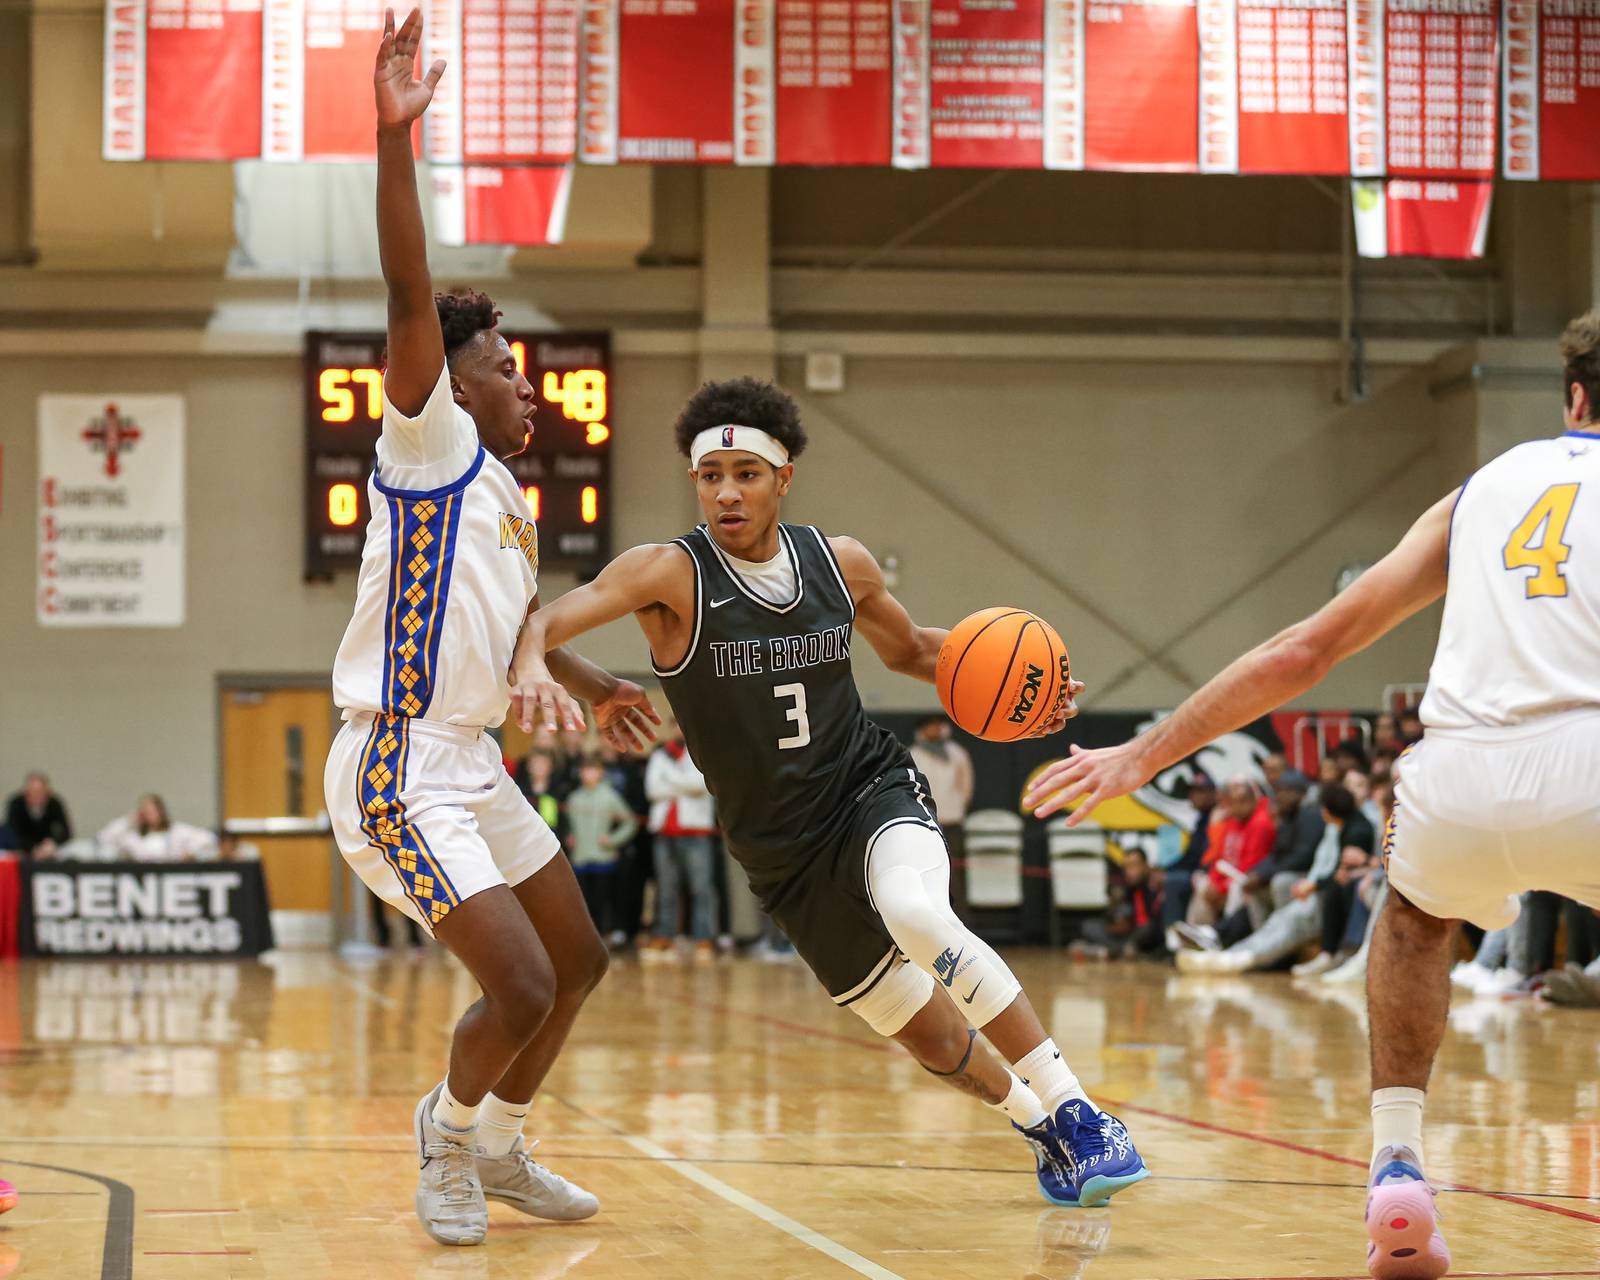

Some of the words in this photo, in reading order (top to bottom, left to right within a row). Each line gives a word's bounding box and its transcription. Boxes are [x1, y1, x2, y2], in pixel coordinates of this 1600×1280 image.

[1508, 0, 1532, 83] TRAC
[585, 0, 608, 154] FOOTBA
[1508, 92, 1532, 172] BOYS
[319, 369, 383, 422] 57
[543, 369, 607, 422] 48
[328, 484, 357, 526] 0
[581, 486, 597, 523] 1
[1501, 482, 1581, 599] 4
[709, 639, 763, 678] THE
[768, 623, 850, 673] BROOK
[773, 682, 811, 750] 3
[1008, 663, 1044, 724] NCAA
[32, 871, 242, 919] BENET
[35, 917, 242, 952] REDWINGS
[931, 946, 955, 977] NIKE
